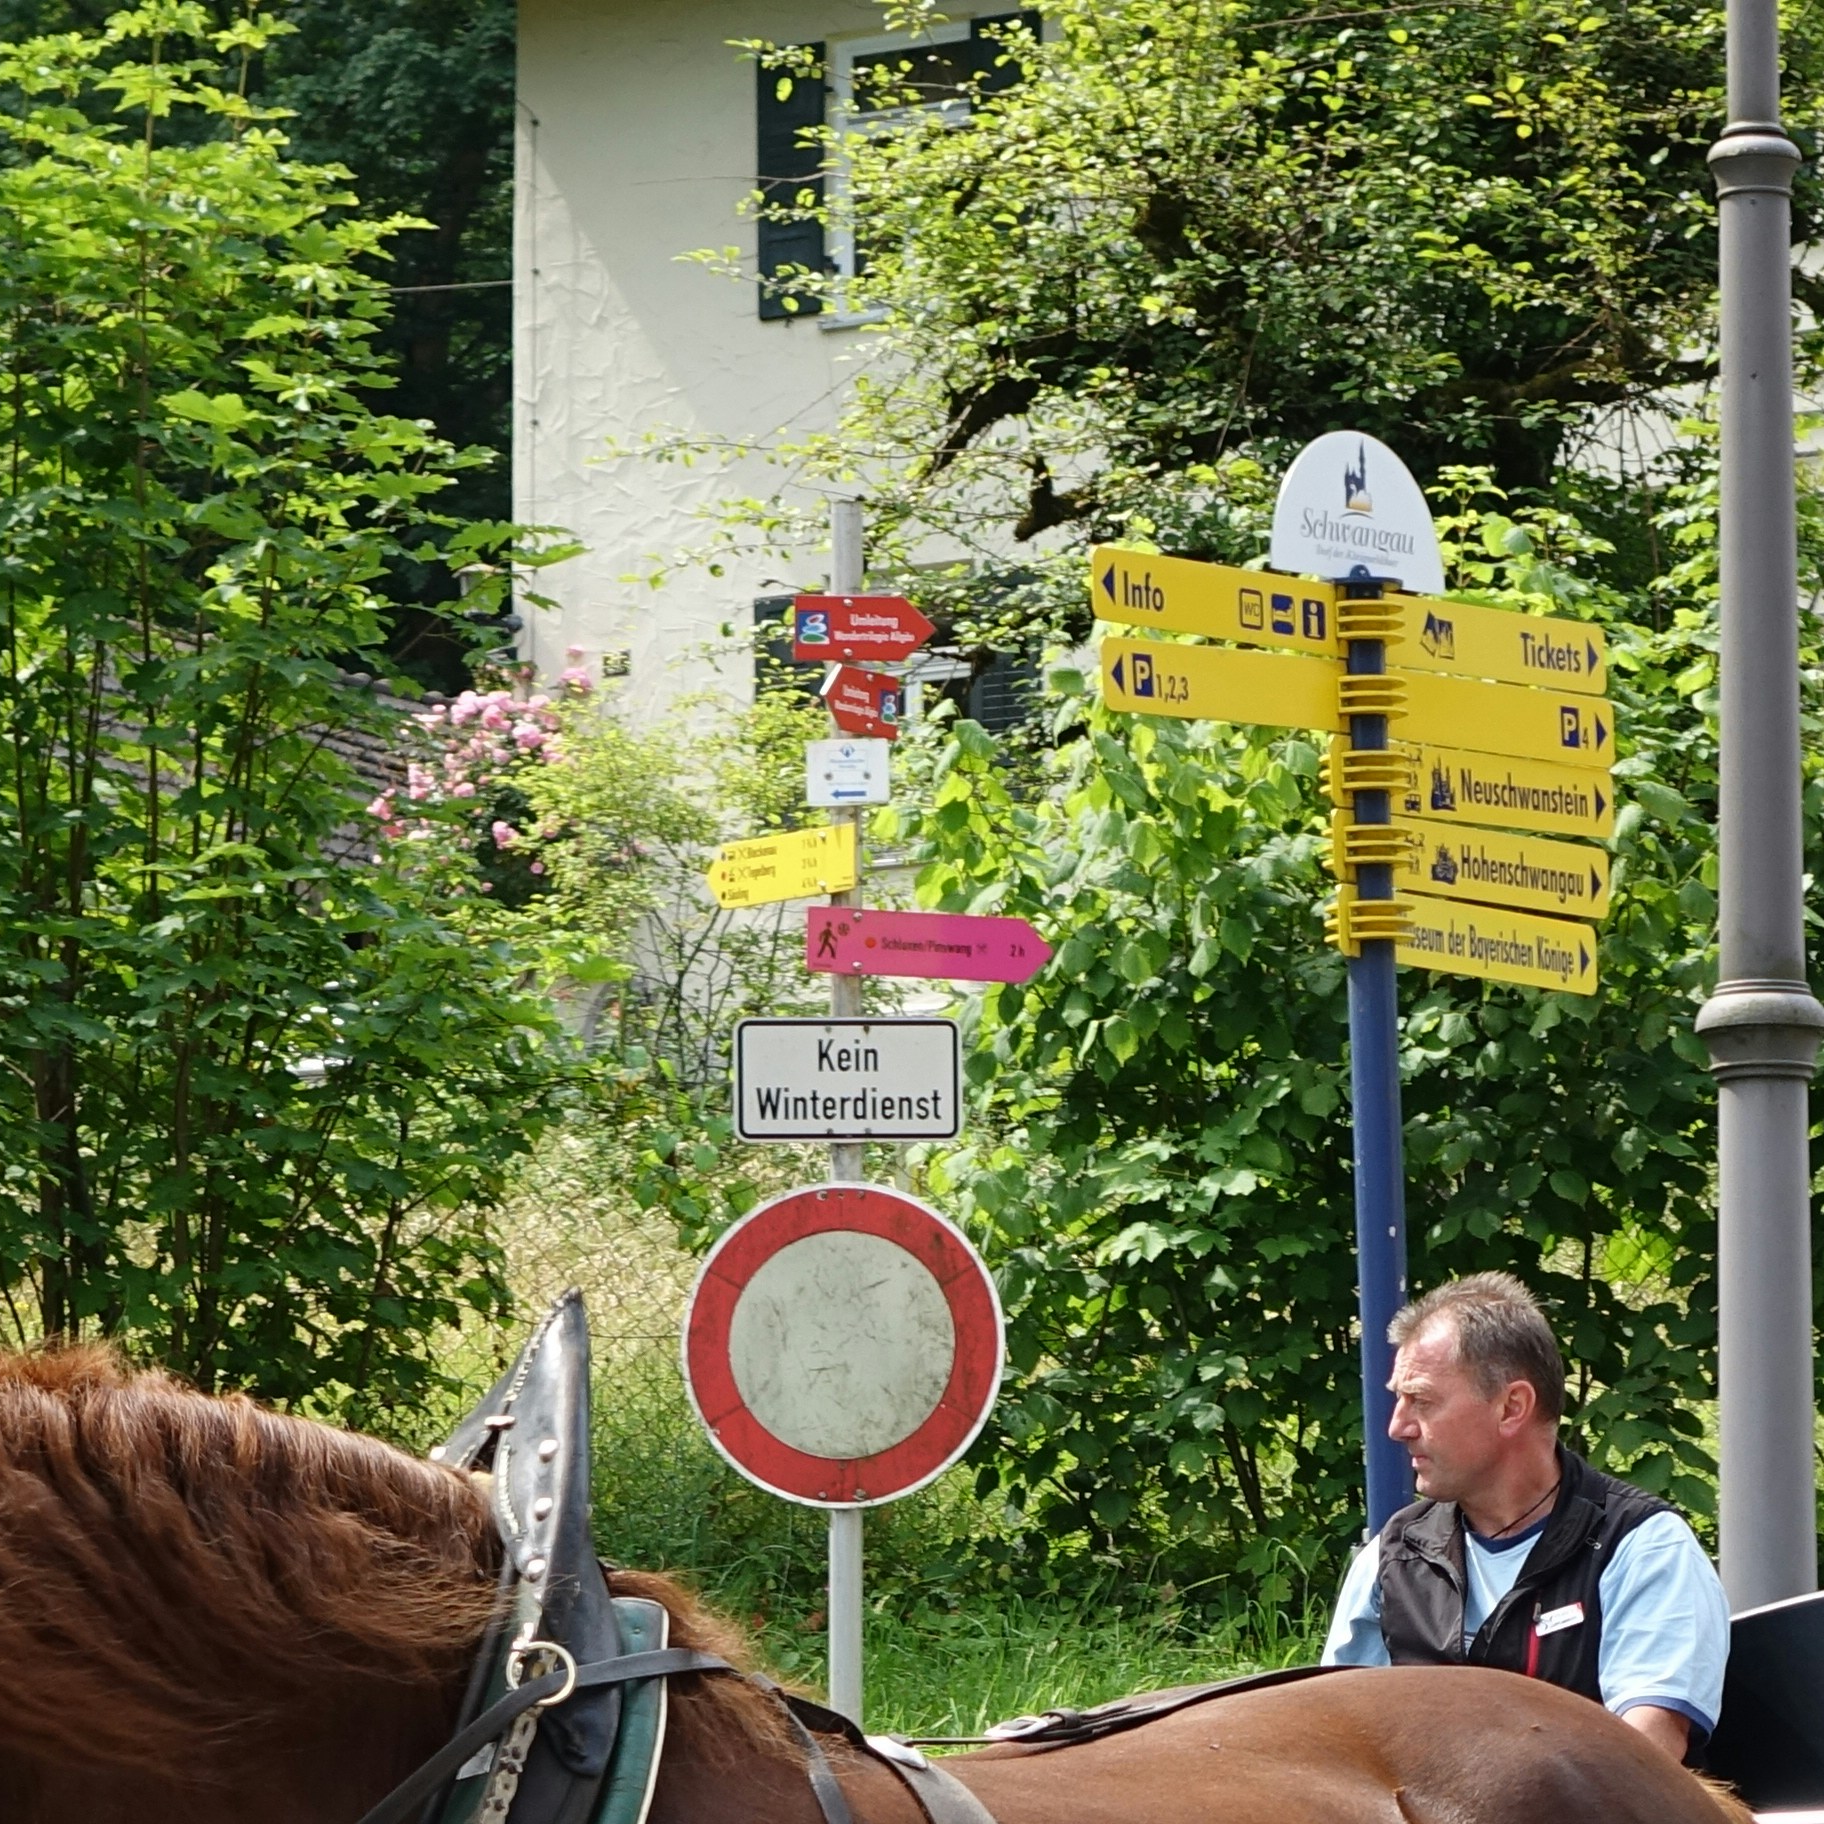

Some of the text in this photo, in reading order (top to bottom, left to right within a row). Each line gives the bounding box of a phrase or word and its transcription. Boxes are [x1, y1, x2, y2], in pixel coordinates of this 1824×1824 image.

[1300, 507, 1415, 555] Schwangau
[1123, 570, 1165, 612] Info
[850, 613, 899, 629] Umleitung
[1520, 631, 1581, 673] Tickets
[1155, 673, 1189, 704] 1,2,3
[1582, 726, 1589, 749] 4
[1460, 768, 1589, 817] Neuschwanstein
[1460, 844, 1585, 904] Hohenschwangau
[1009, 943, 1017, 958] 2
[1448, 918, 1466, 957] der
[1469, 924, 1534, 969] Bayerischen
[1536, 935, 1574, 983] Könige
[817, 1038, 879, 1072] Kein
[756, 1087, 942, 1120] Winterdienst
